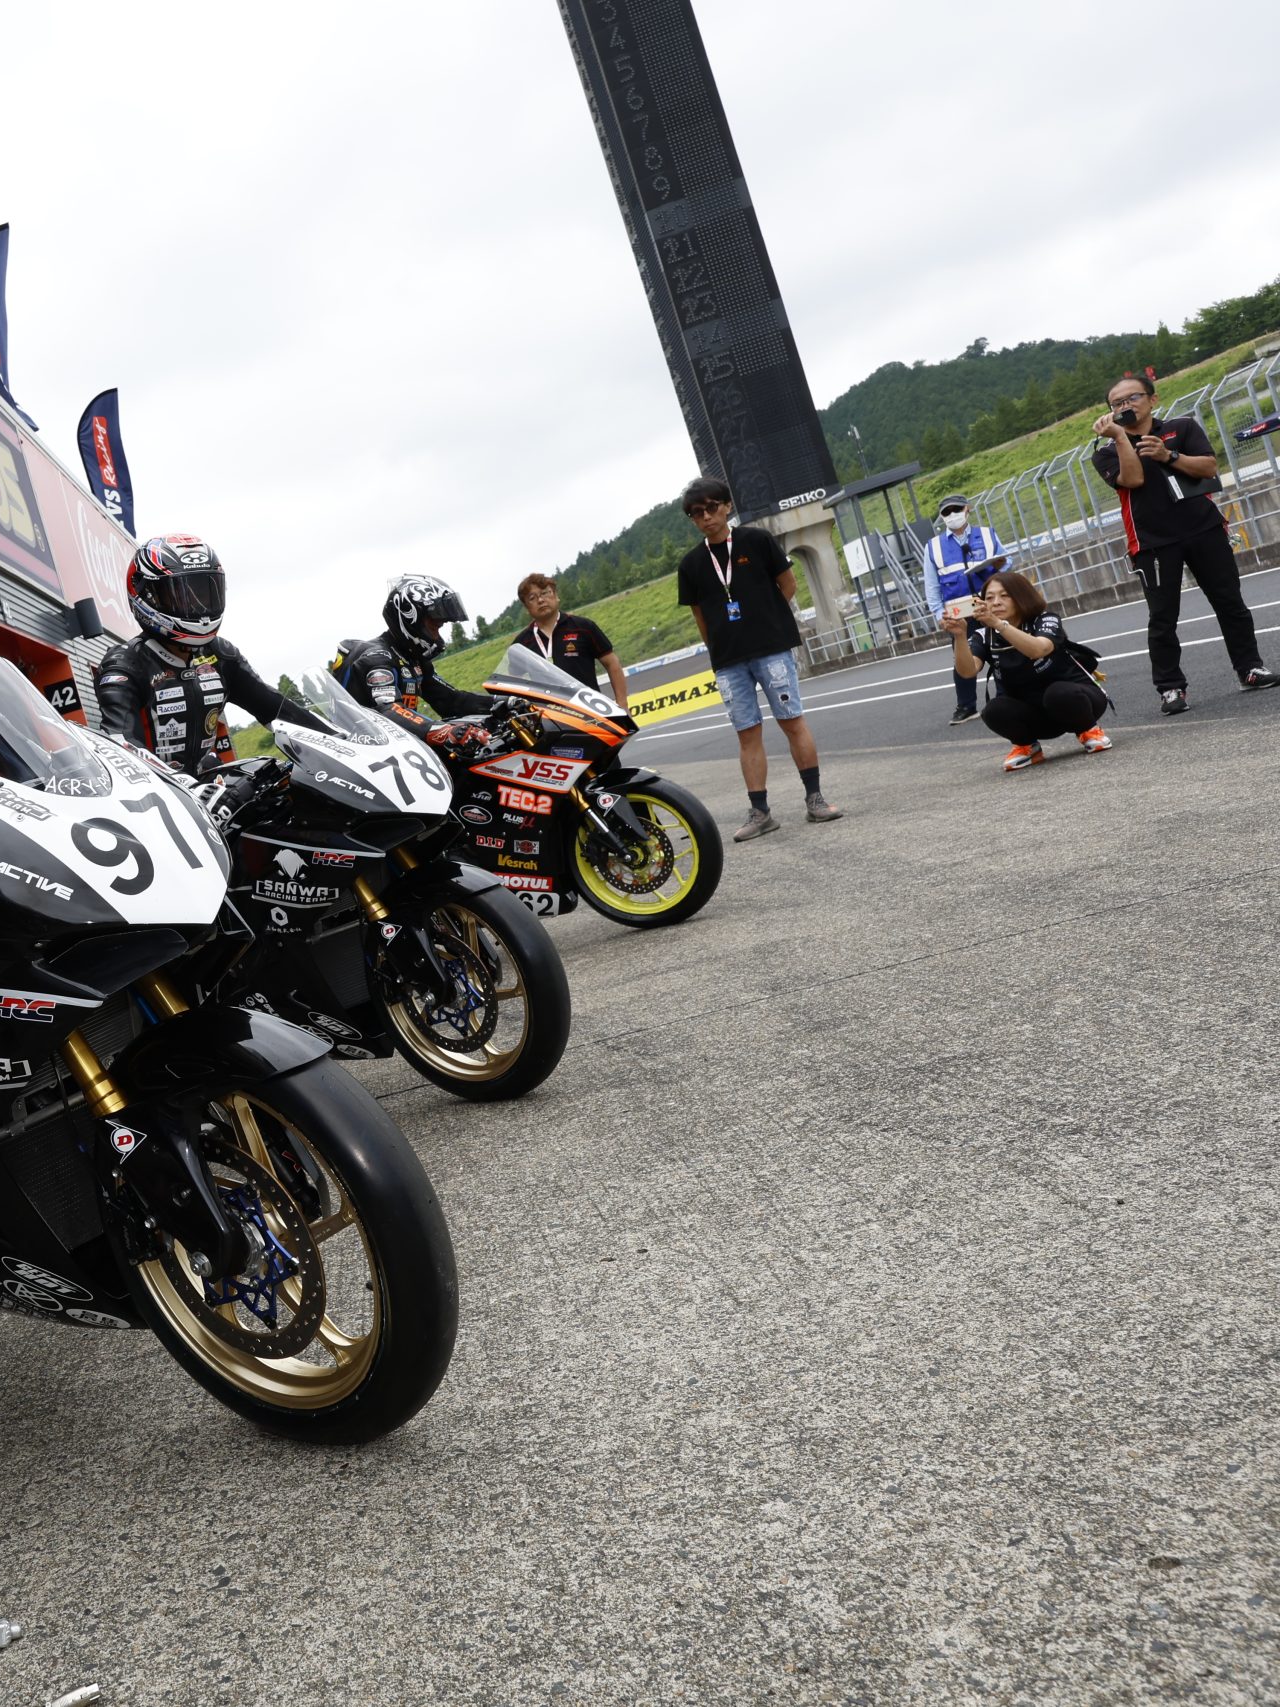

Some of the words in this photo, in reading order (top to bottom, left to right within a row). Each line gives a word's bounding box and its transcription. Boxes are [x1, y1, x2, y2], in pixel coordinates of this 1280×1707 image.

[777, 488, 827, 511] SEIKO
[51, 686, 77, 708] 42
[578, 691, 613, 715] 6
[216, 739, 230, 750] 45
[368, 751, 445, 806] 78
[517, 758, 574, 781] YSS
[328, 777, 376, 800] ACTIVE
[497, 784, 553, 815] TEC.2
[71, 792, 204, 896] 97
[476, 835, 505, 849] D.I.D
[312, 851, 356, 868] HRC
[498, 854, 539, 870] Vesrah
[263, 880, 329, 897] SANWA
[266, 891, 297, 901] RACING
